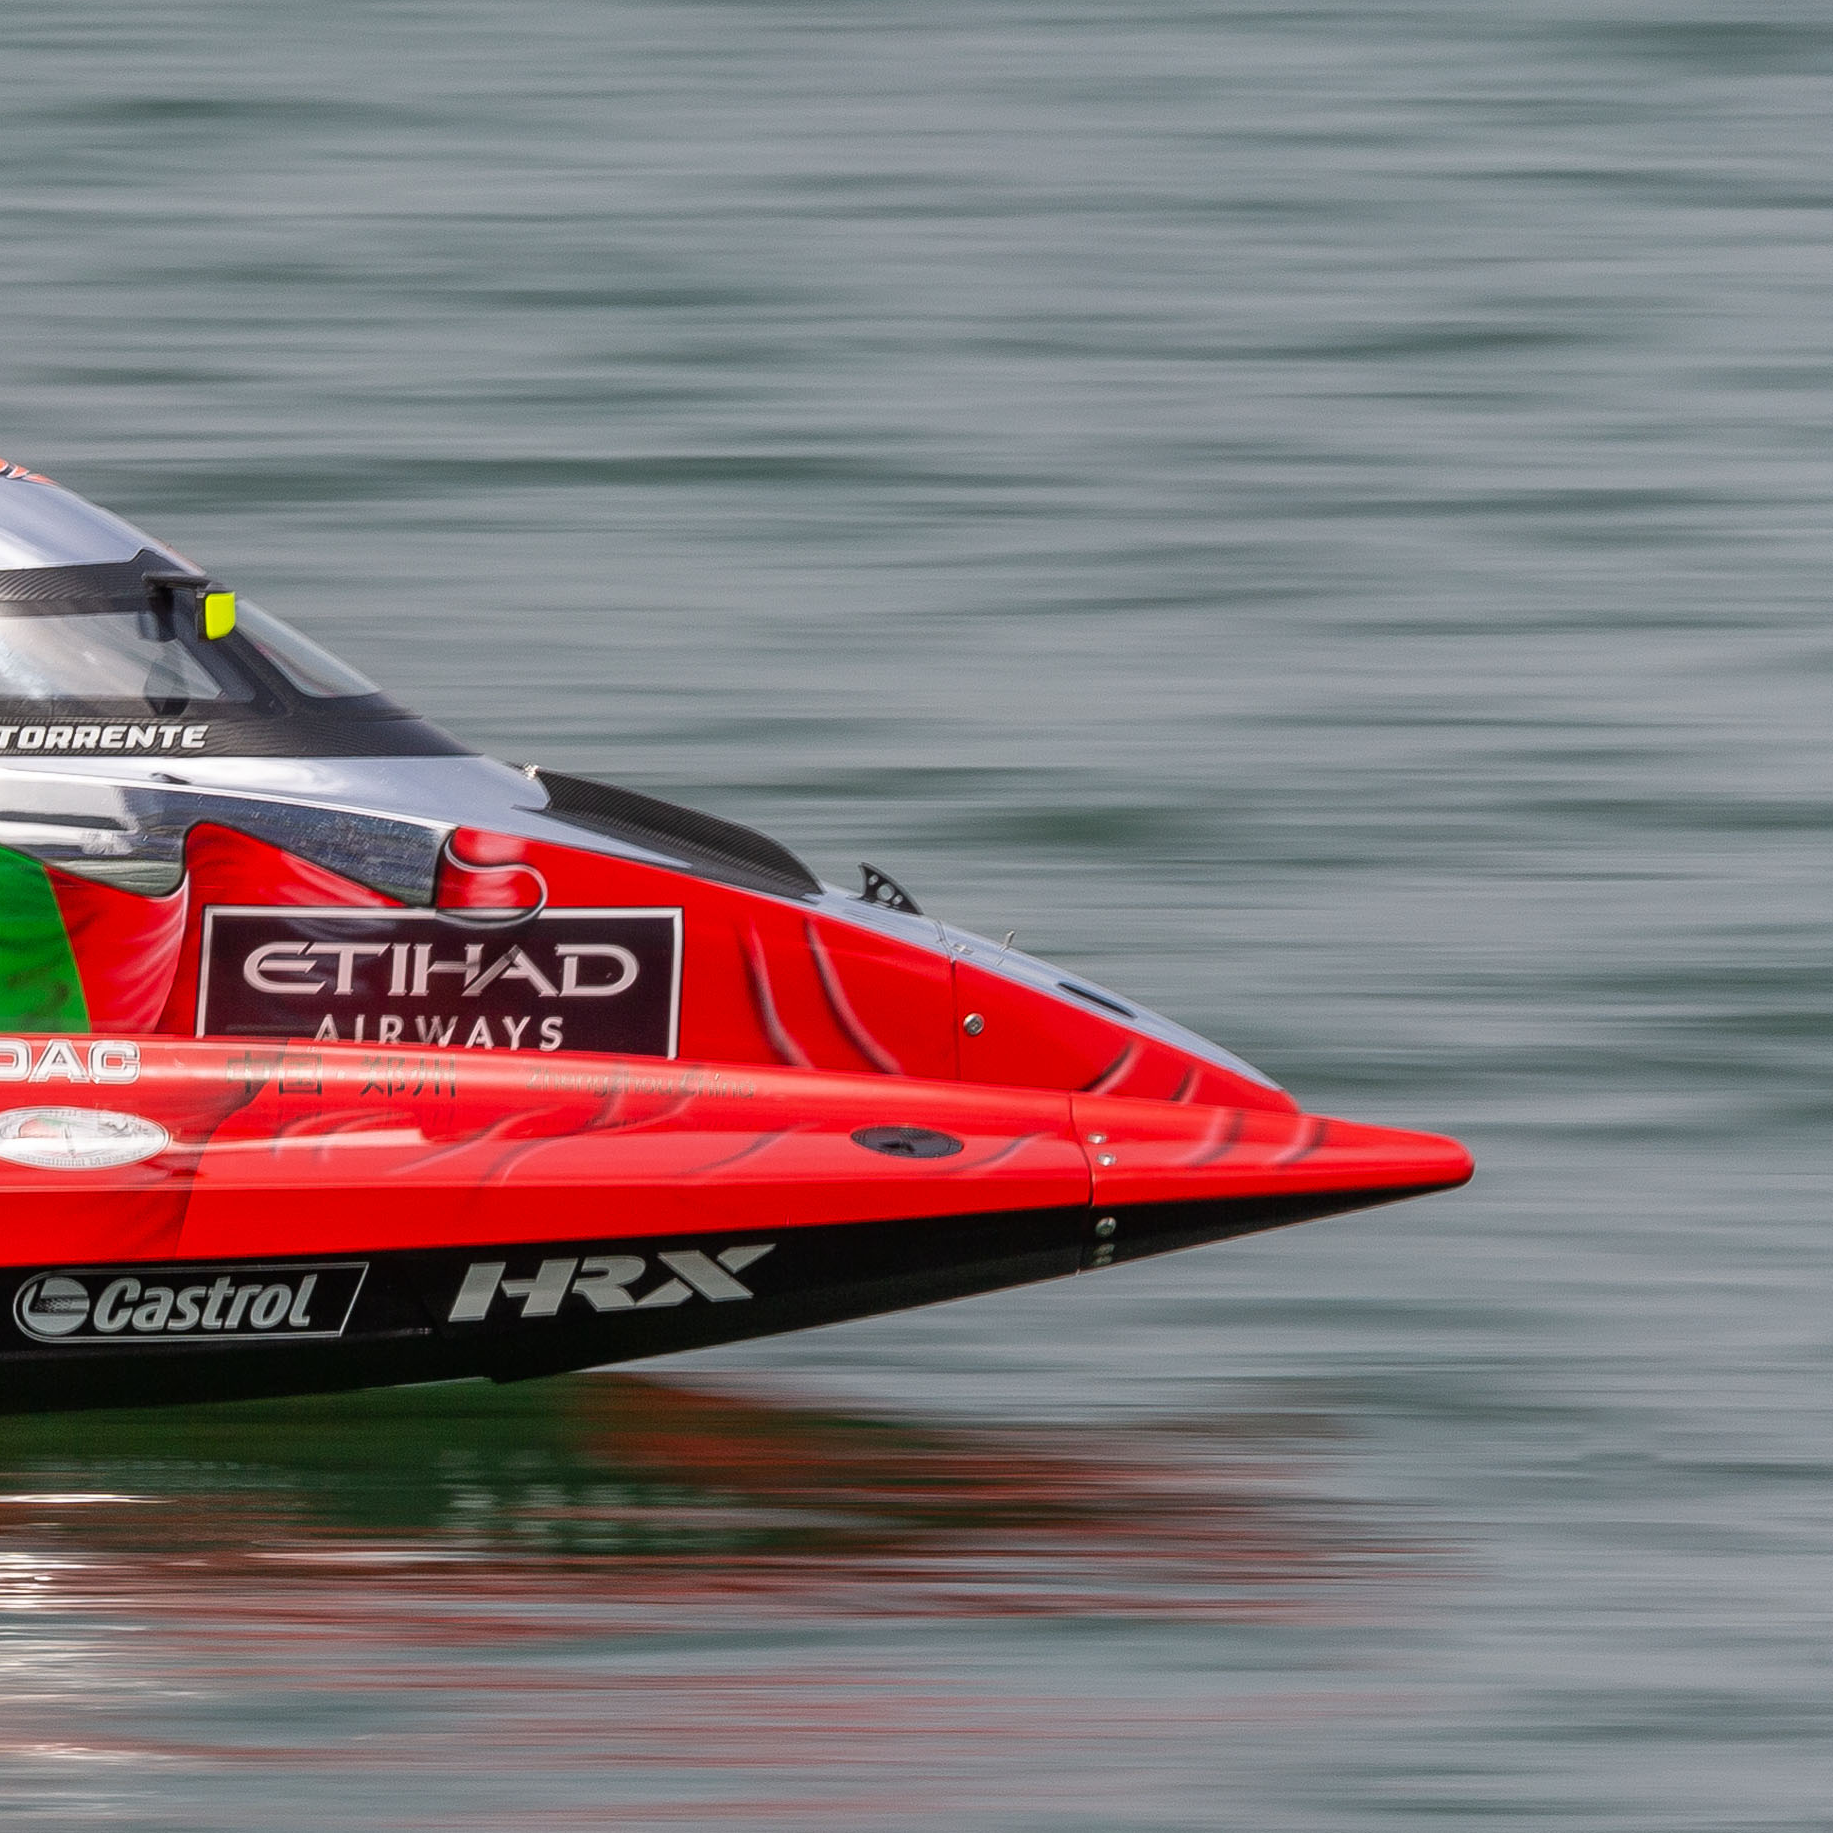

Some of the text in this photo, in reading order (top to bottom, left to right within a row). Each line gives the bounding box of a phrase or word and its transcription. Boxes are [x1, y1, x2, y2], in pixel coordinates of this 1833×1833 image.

[242, 940, 641, 998] ETIHAD
[313, 1013, 565, 1053] AIRWAYS
[93, 1274, 319, 1334] Castrol
[447, 1243, 777, 1323] HRX
